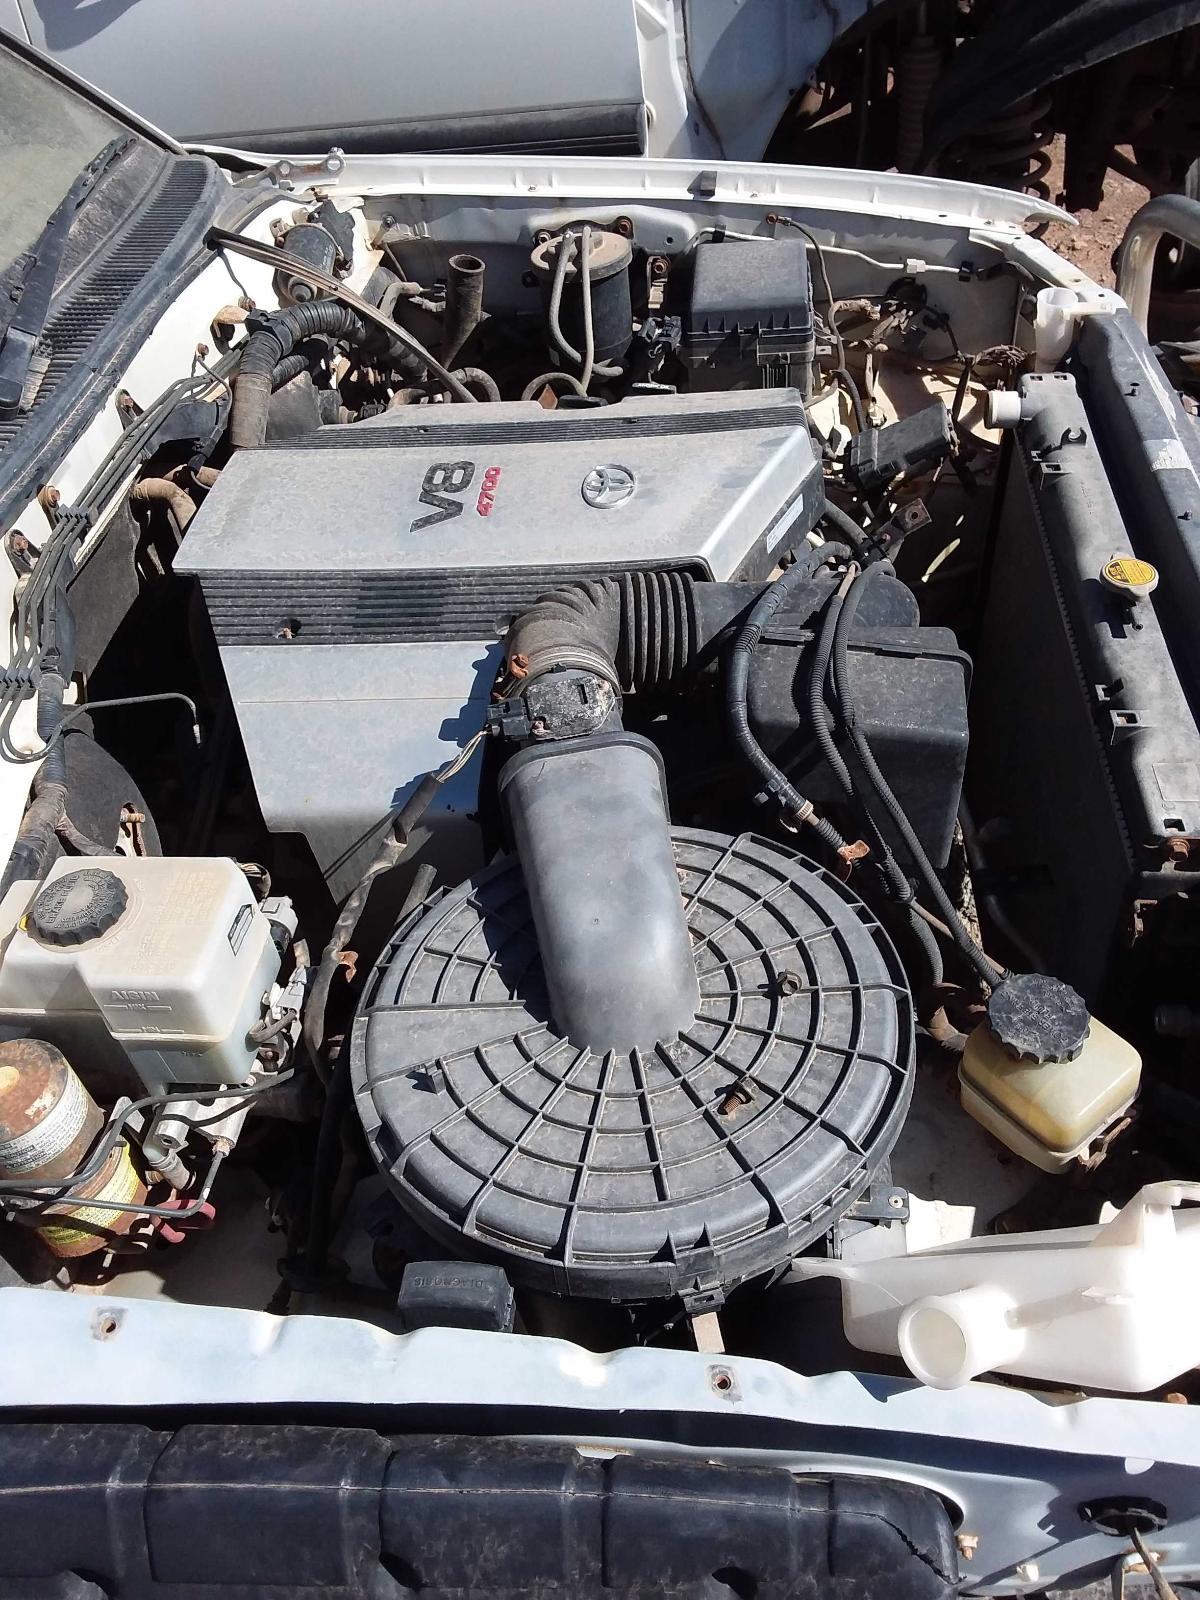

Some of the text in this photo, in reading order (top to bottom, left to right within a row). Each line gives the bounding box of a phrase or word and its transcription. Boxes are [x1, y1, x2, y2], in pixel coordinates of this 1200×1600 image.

[409, 460, 476, 533] V8
[475, 465, 501, 517] 4700
[111, 990, 160, 1001] AISIN
